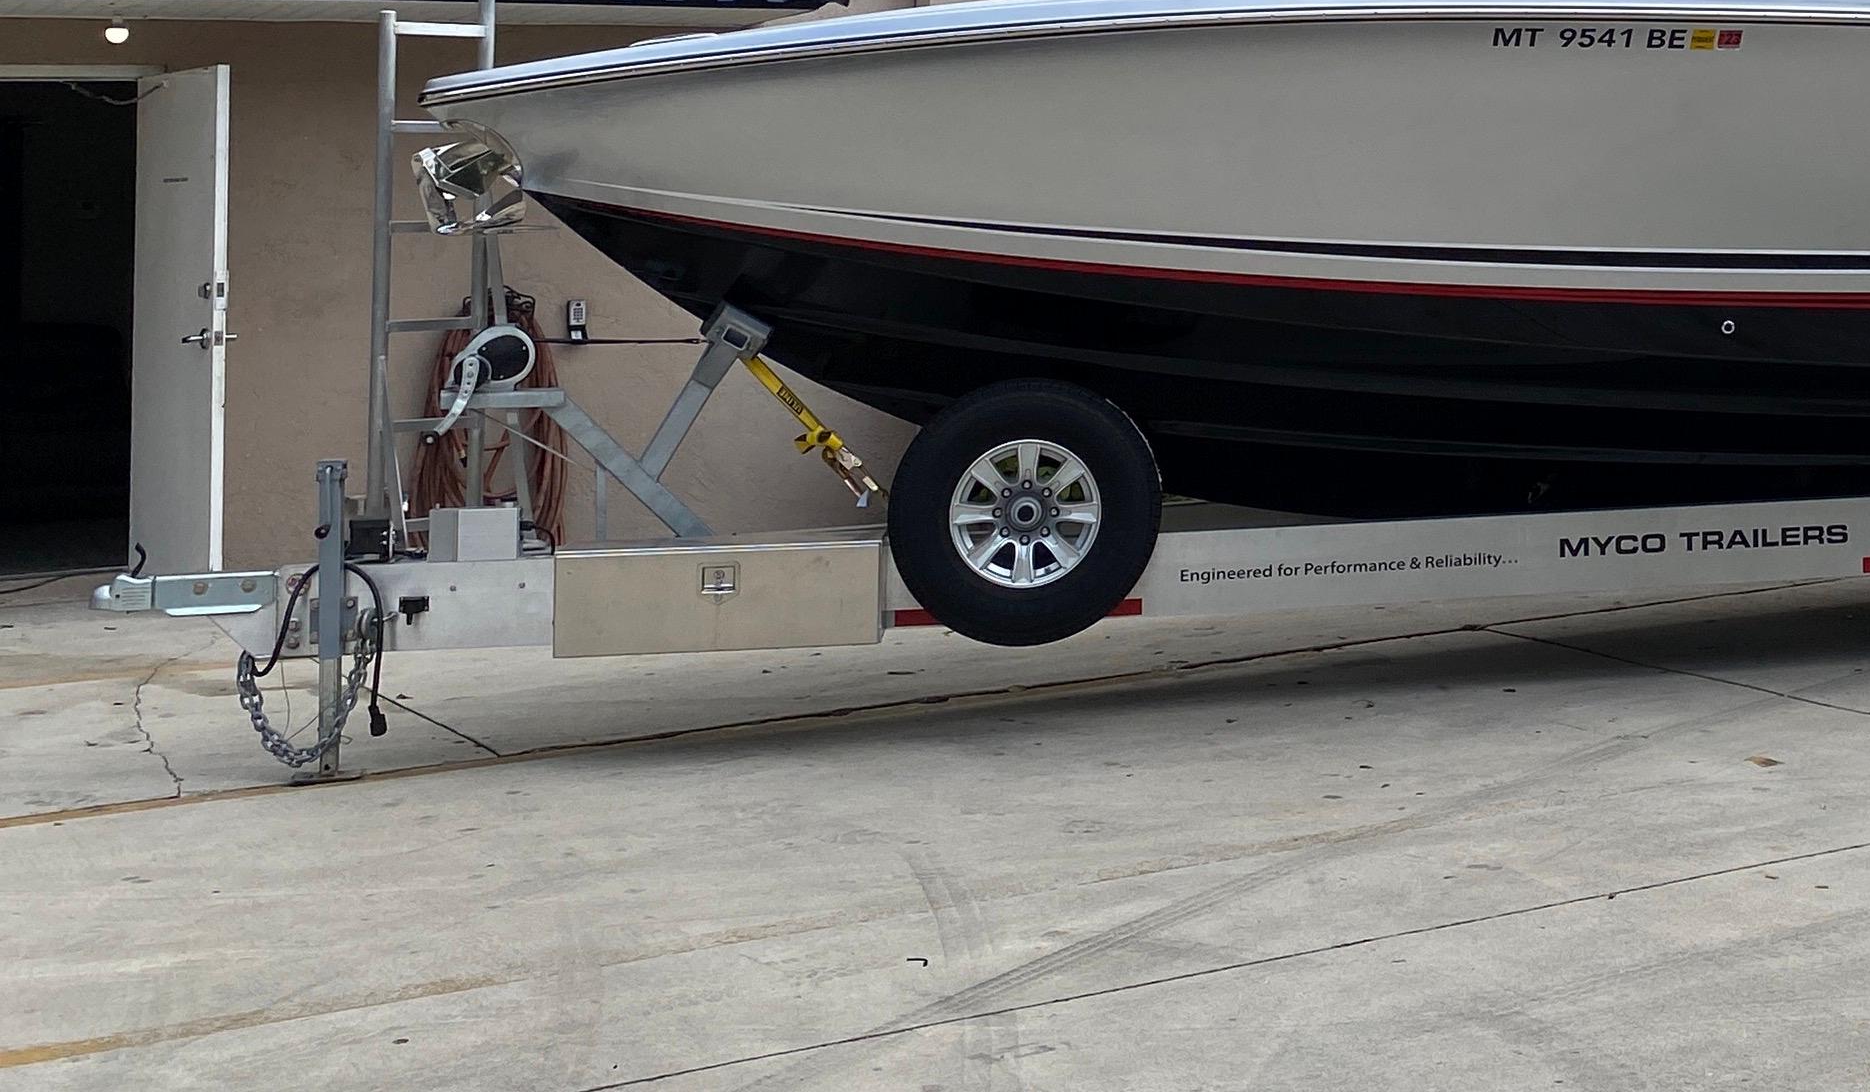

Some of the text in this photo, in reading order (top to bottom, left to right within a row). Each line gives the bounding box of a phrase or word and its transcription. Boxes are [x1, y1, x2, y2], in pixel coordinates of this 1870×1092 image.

[1491, 27, 1544, 48] MT
[1558, 27, 1634, 49] 9541
[1646, 28, 1688, 49] BE
[1559, 524, 1849, 558] MYCO TRAILERS
[1179, 566, 1273, 585] Engineered
[1277, 563, 1300, 578] for
[1304, 558, 1406, 576] Performance
[1409, 556, 1422, 571] &
